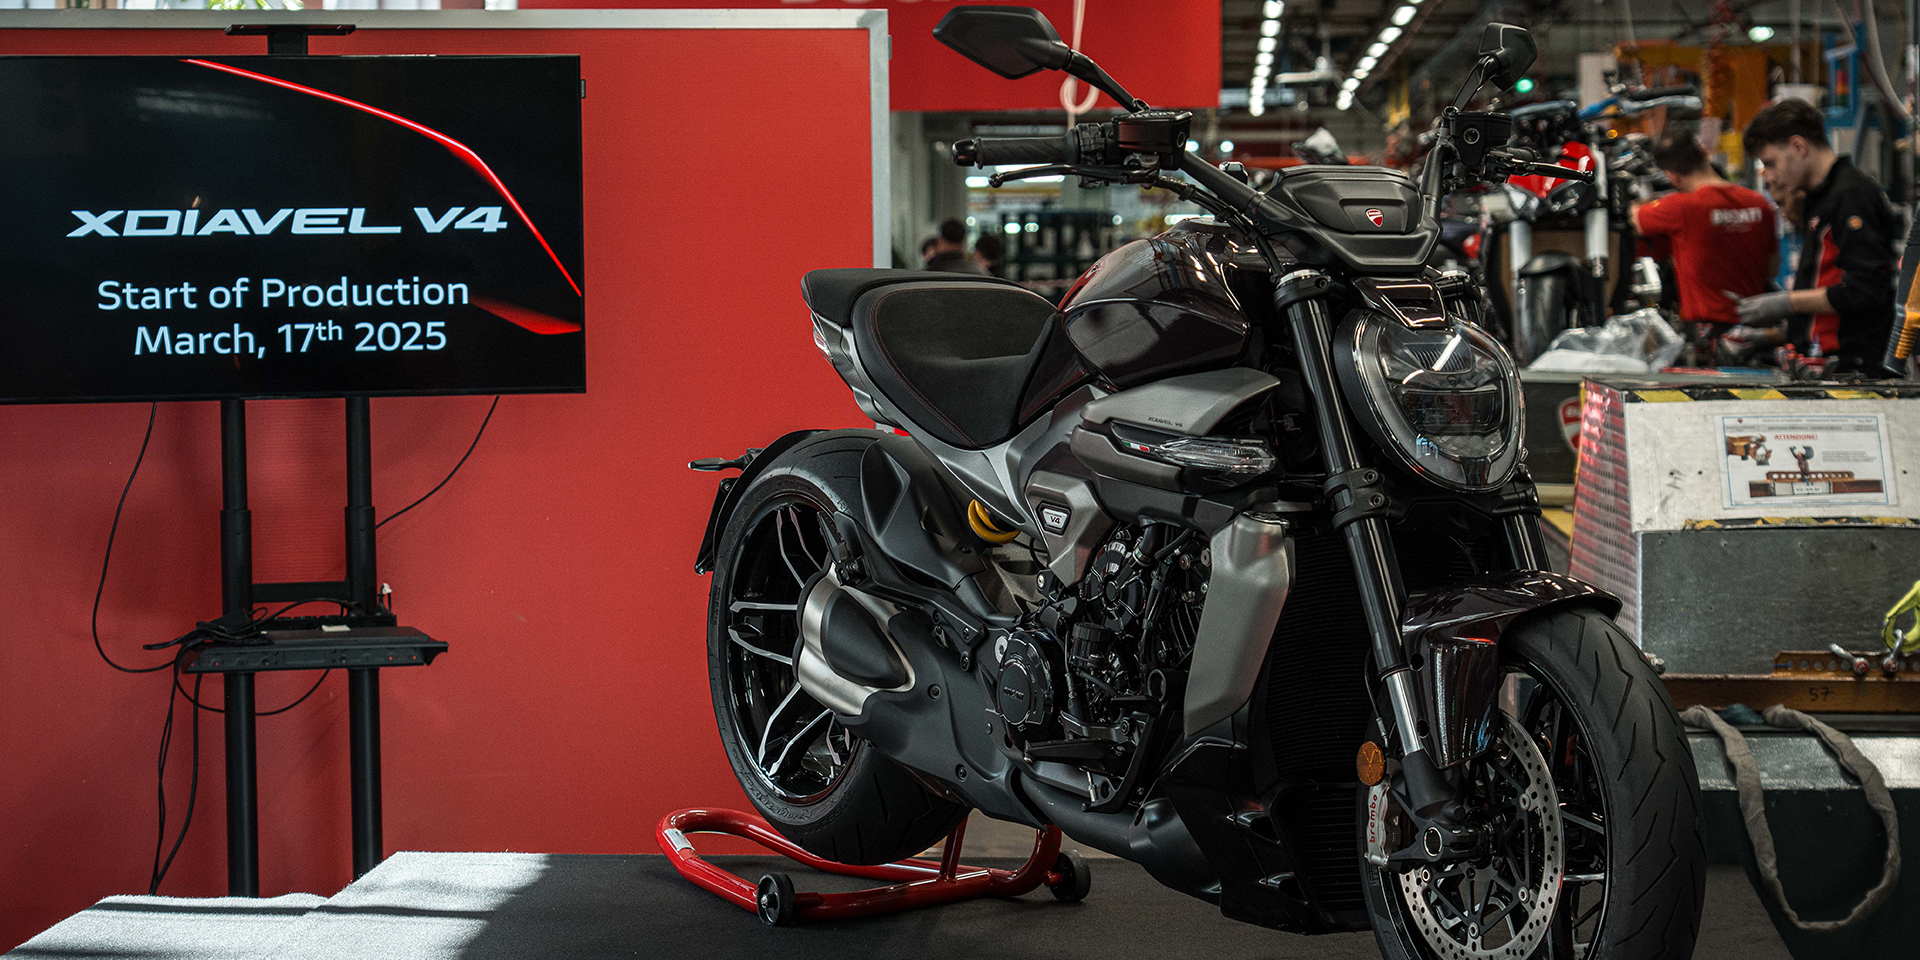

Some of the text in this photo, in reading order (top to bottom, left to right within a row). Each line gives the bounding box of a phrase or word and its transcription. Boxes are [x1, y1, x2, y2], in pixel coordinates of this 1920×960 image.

[66, 206, 507, 237] XDIAVEL V4
[98, 276, 468, 310] Start of Production
[135, 320, 446, 359] March, 17th 2025
[1050, 515, 1060, 524] V4
[1809, 687, 1834, 702] 57
[1369, 794, 1377, 843] brembo
